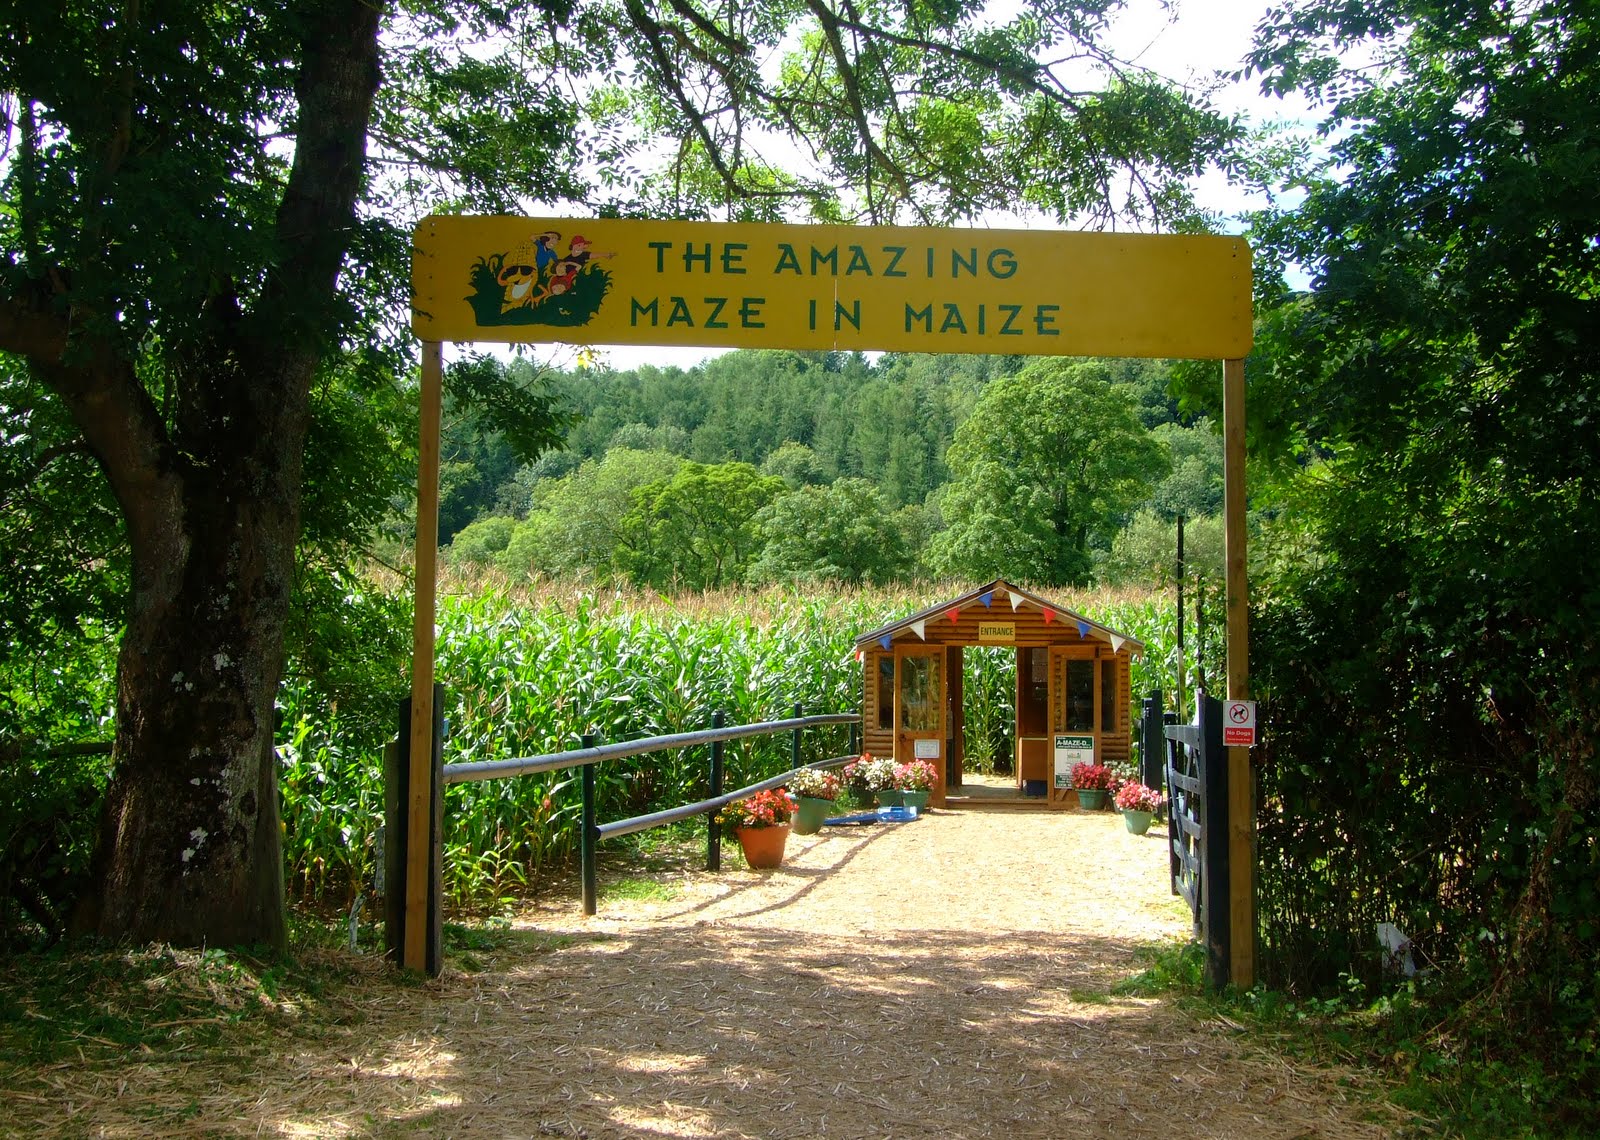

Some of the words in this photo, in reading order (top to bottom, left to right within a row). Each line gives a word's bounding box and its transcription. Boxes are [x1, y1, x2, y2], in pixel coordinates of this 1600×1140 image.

[648, 242, 748, 274] THE
[773, 243, 1018, 279] AMAZING
[630, 296, 766, 329] MAZE
[809, 299, 860, 331] IN
[904, 302, 1060, 335] MAIZE
[980, 627, 1014, 636] ENTRANCE
